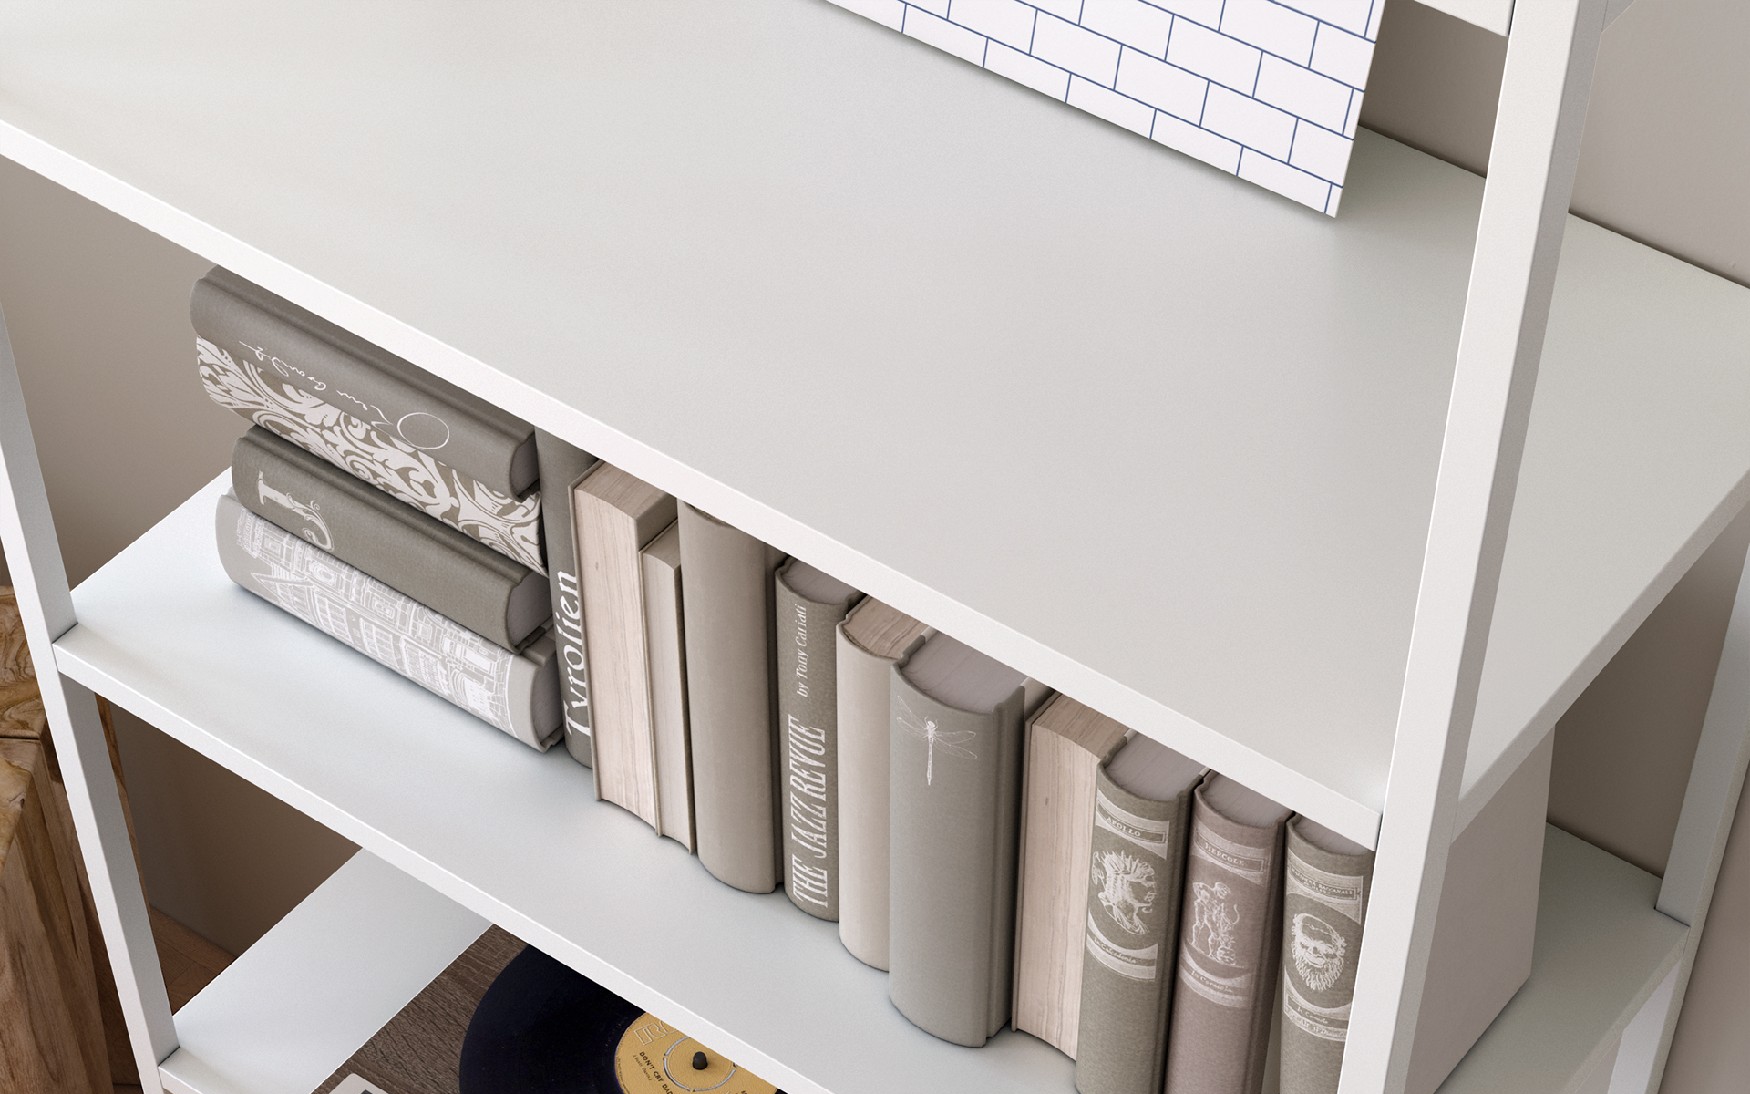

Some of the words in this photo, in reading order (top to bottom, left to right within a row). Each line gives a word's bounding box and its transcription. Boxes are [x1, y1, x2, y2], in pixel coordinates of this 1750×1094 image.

[794, 603, 807, 647] Cariati
[795, 648, 808, 679] Tony
[796, 682, 809, 697] by
[788, 715, 826, 799] REVUE
[790, 791, 826, 858] JAZZ
[1105, 817, 1142, 837] APOLLO
[792, 853, 827, 907] THE
